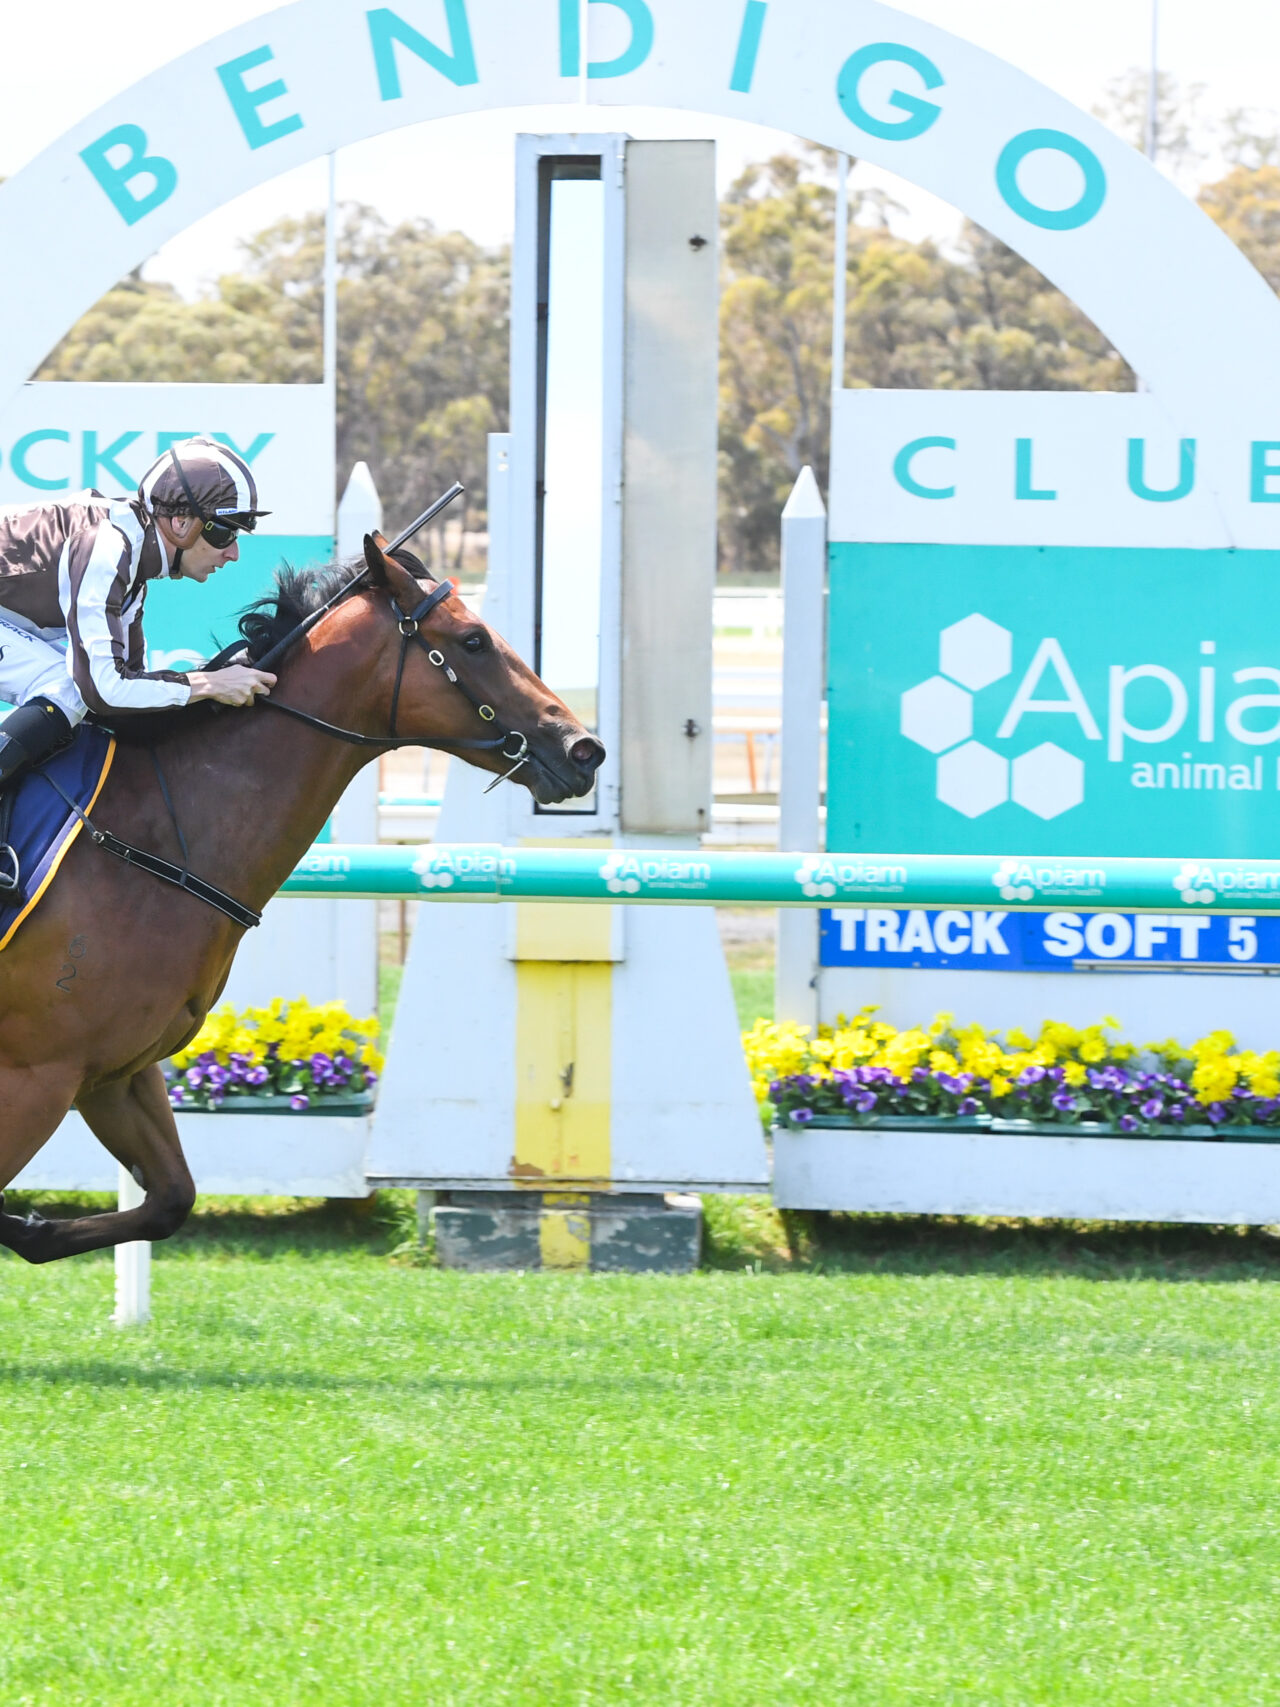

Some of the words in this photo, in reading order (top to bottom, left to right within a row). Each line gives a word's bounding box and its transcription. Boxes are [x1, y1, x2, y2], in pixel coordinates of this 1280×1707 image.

[79, 0, 1108, 232] BENDIGO
[1131, 752, 1263, 791] animal
[296, 852, 351, 872] iam
[624, 857, 712, 884] Apiam
[816, 859, 908, 886] Apiam
[1013, 863, 1106, 890] Apiam
[831, 908, 1010, 955] TRACK
[1043, 912, 1210, 959] SOFT
[1227, 917, 1258, 961] 5
